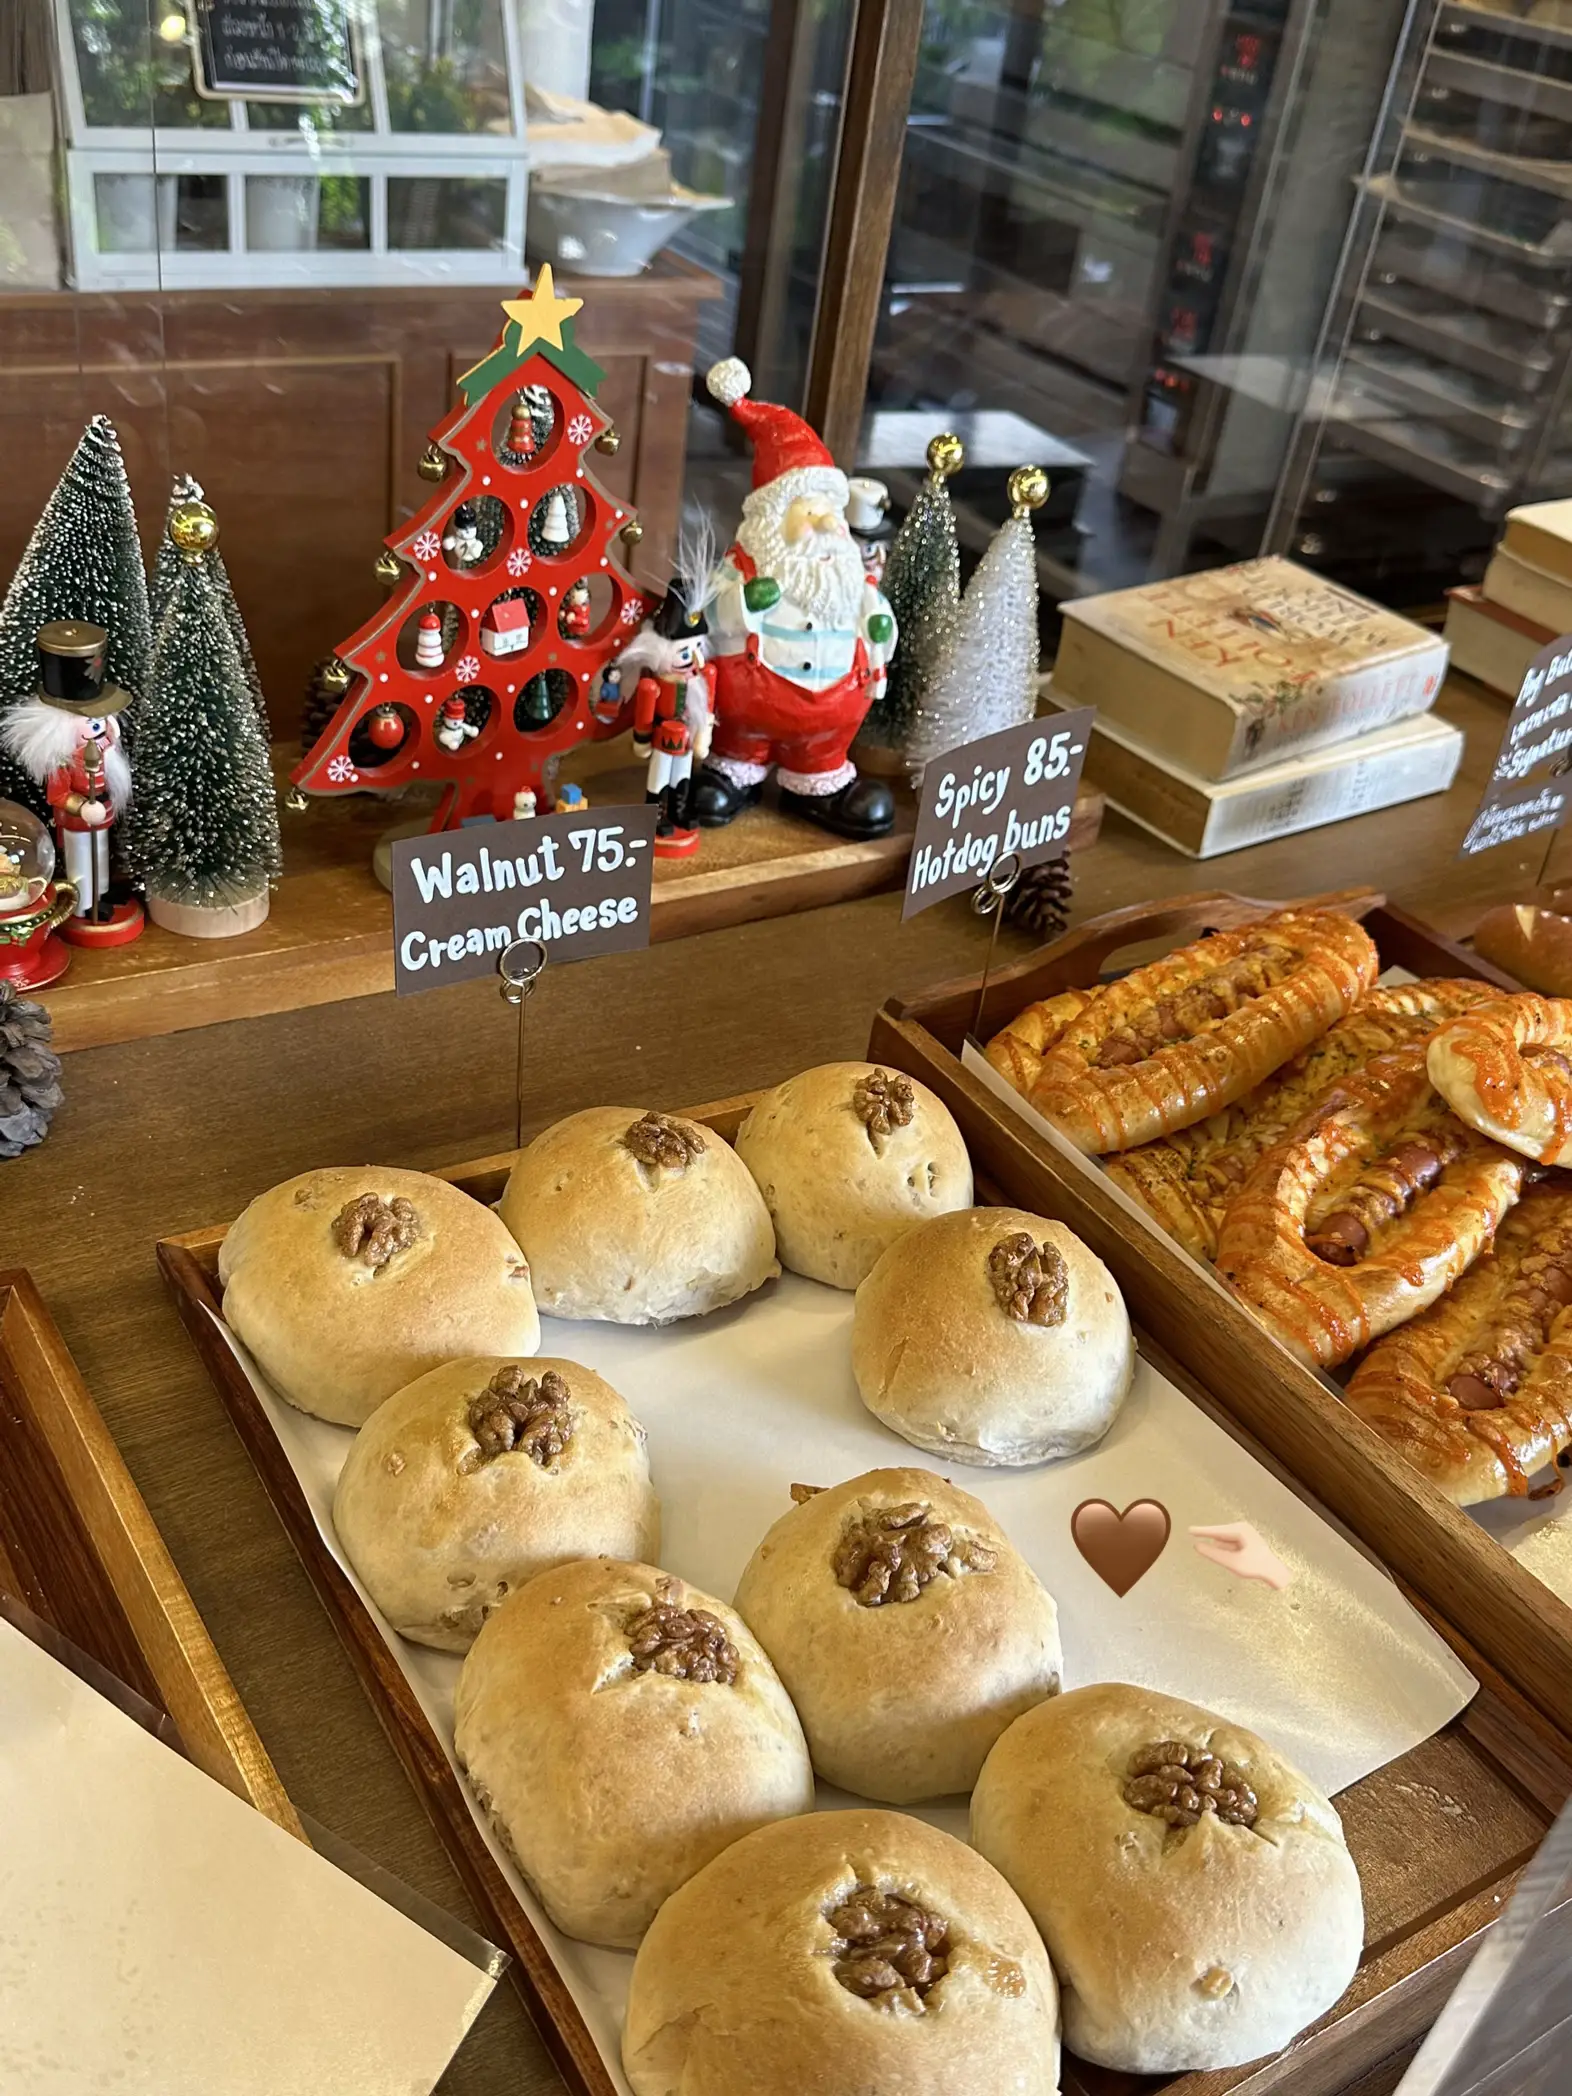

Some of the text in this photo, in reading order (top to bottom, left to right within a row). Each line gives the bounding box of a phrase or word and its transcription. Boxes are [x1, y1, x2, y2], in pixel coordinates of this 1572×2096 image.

[934, 731, 1084, 829] Spicy 85.-
[410, 825, 648, 904] Walnut 75.-
[911, 805, 1071, 895] Hotdog buns
[400, 897, 639, 972] Cream Cheese
